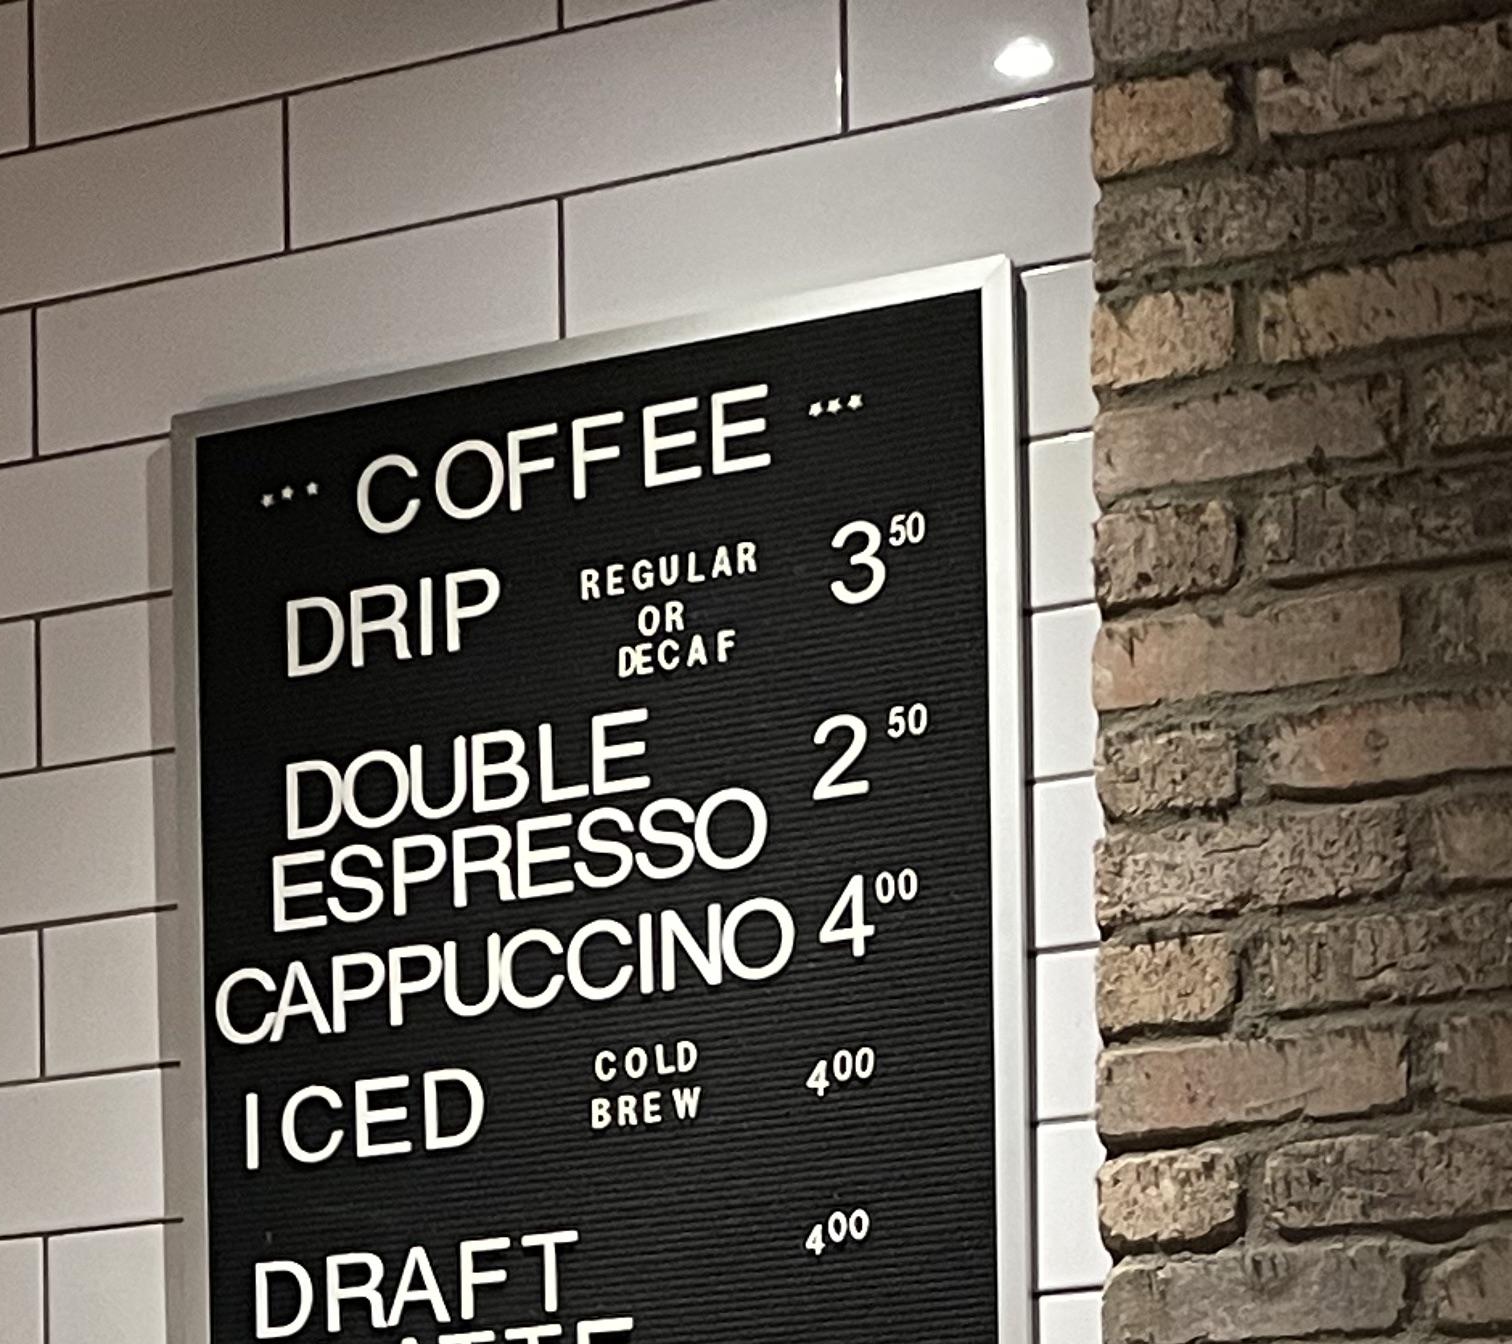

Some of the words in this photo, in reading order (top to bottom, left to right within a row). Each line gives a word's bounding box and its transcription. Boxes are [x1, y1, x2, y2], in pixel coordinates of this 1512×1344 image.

[357, 384, 771, 533] COFFEE
[287, 568, 500, 677] DRIP
[581, 542, 756, 600] REGULAR
[638, 601, 685, 636] OR
[619, 630, 736, 677] DECAF
[286, 708, 650, 840] DOUBLE
[273, 788, 767, 932] ESPRESSO
[216, 897, 795, 1044] CAPPUCCINO
[592, 1087, 701, 1128] BREW
[595, 1041, 698, 1081] COLD
[246, 1069, 484, 1169] ICED
[255, 1230, 578, 1339] DRAFT
